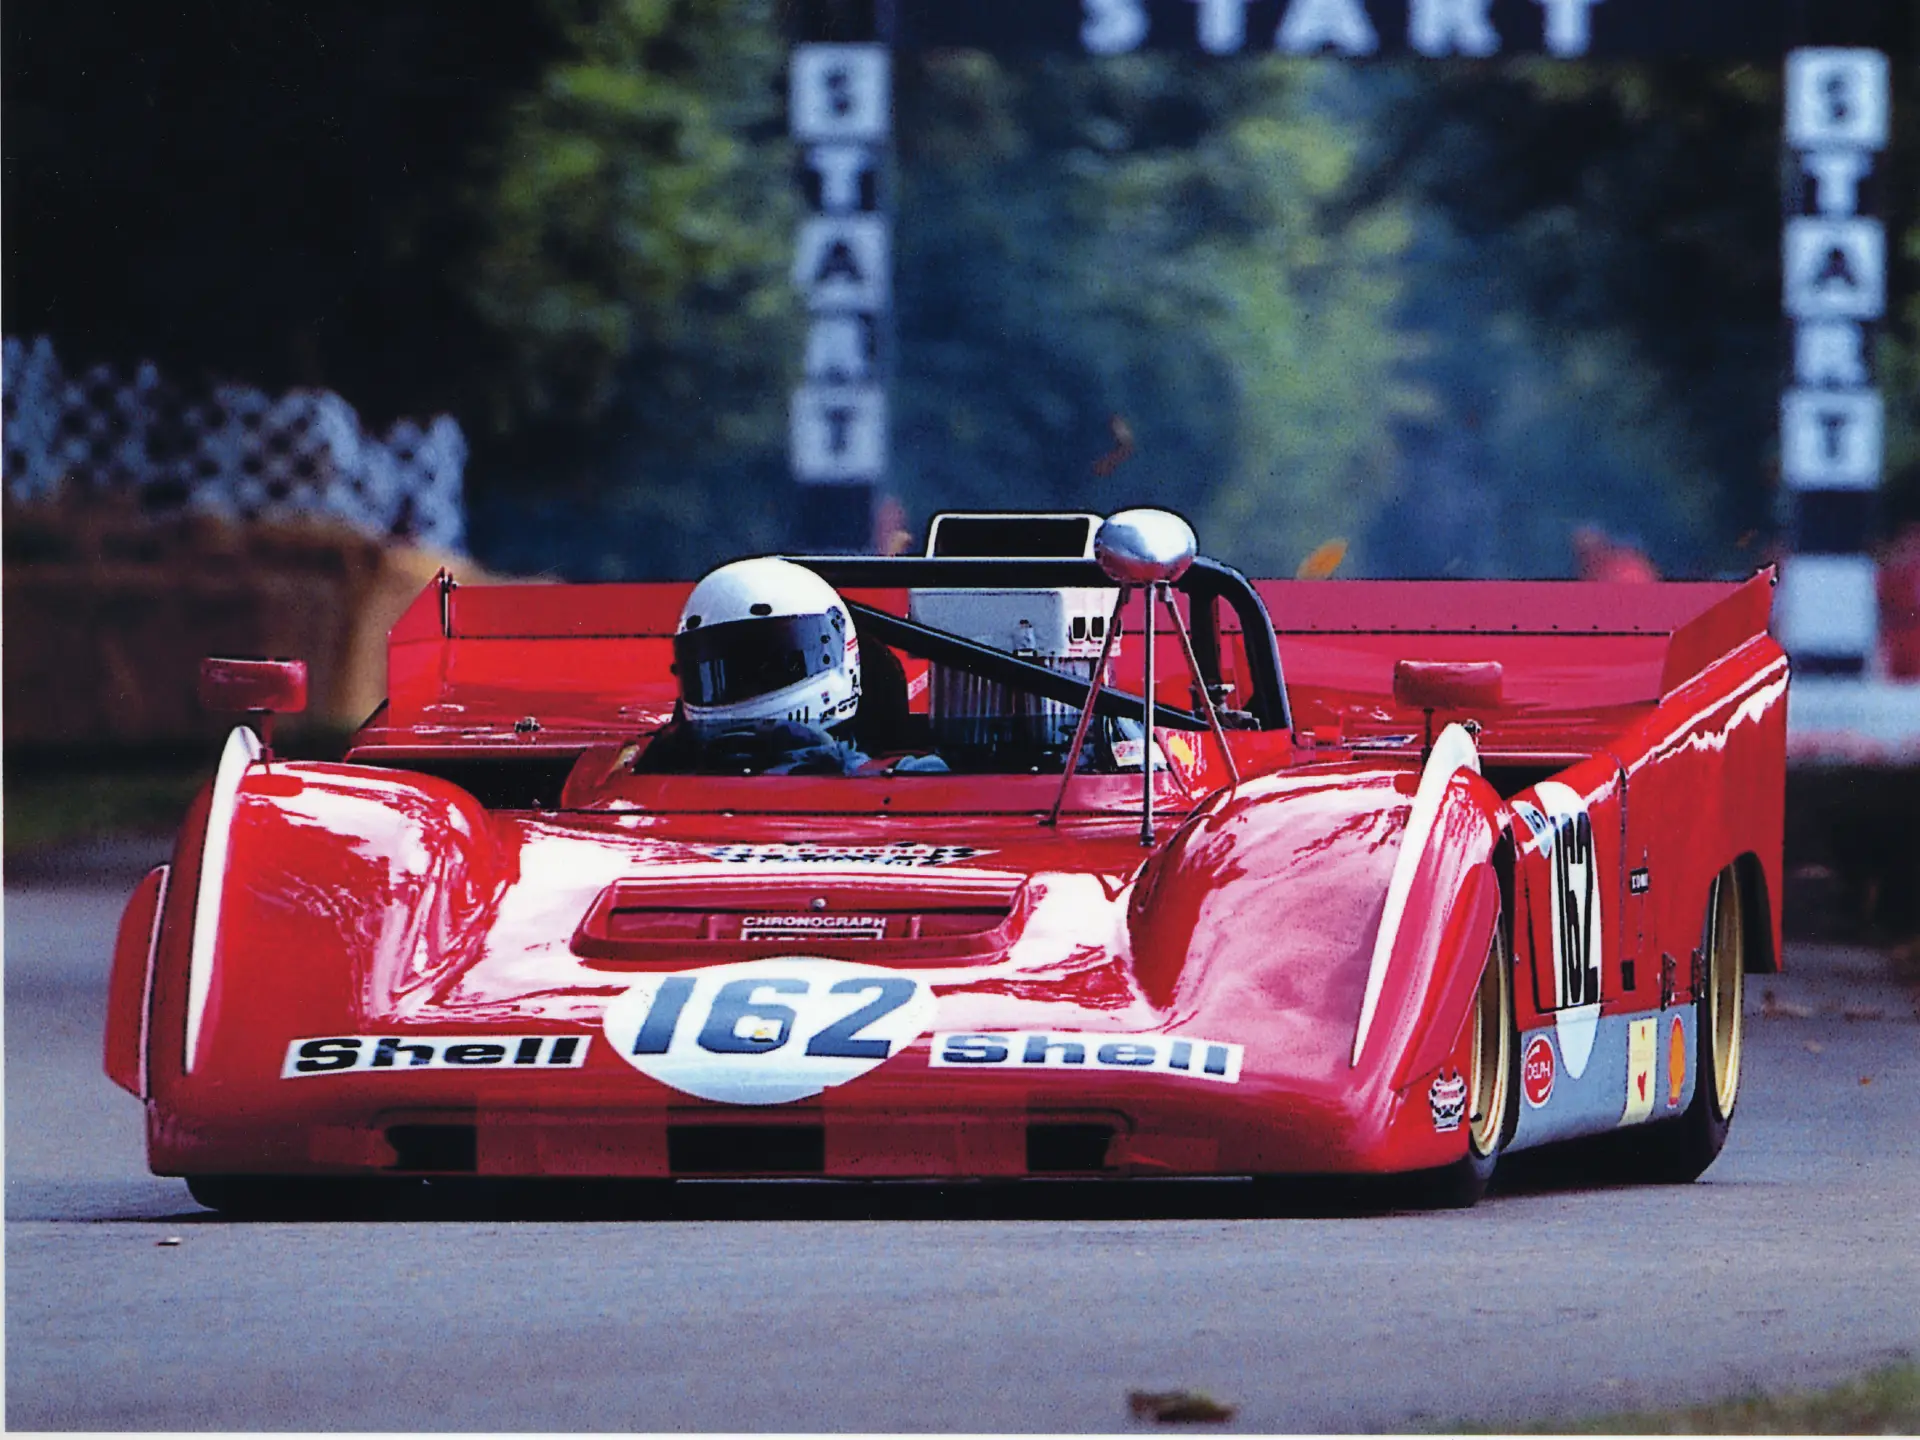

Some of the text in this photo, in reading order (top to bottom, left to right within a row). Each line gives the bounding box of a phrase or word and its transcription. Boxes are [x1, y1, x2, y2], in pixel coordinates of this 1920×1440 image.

[1080, 0, 1592, 57] START
[742, 916, 887, 928] CHRONOGRAPH
[1550, 811, 1599, 1007] 162
[632, 976, 917, 1059] 162
[295, 1038, 581, 1073] Shell
[942, 1034, 1229, 1075] Shell
